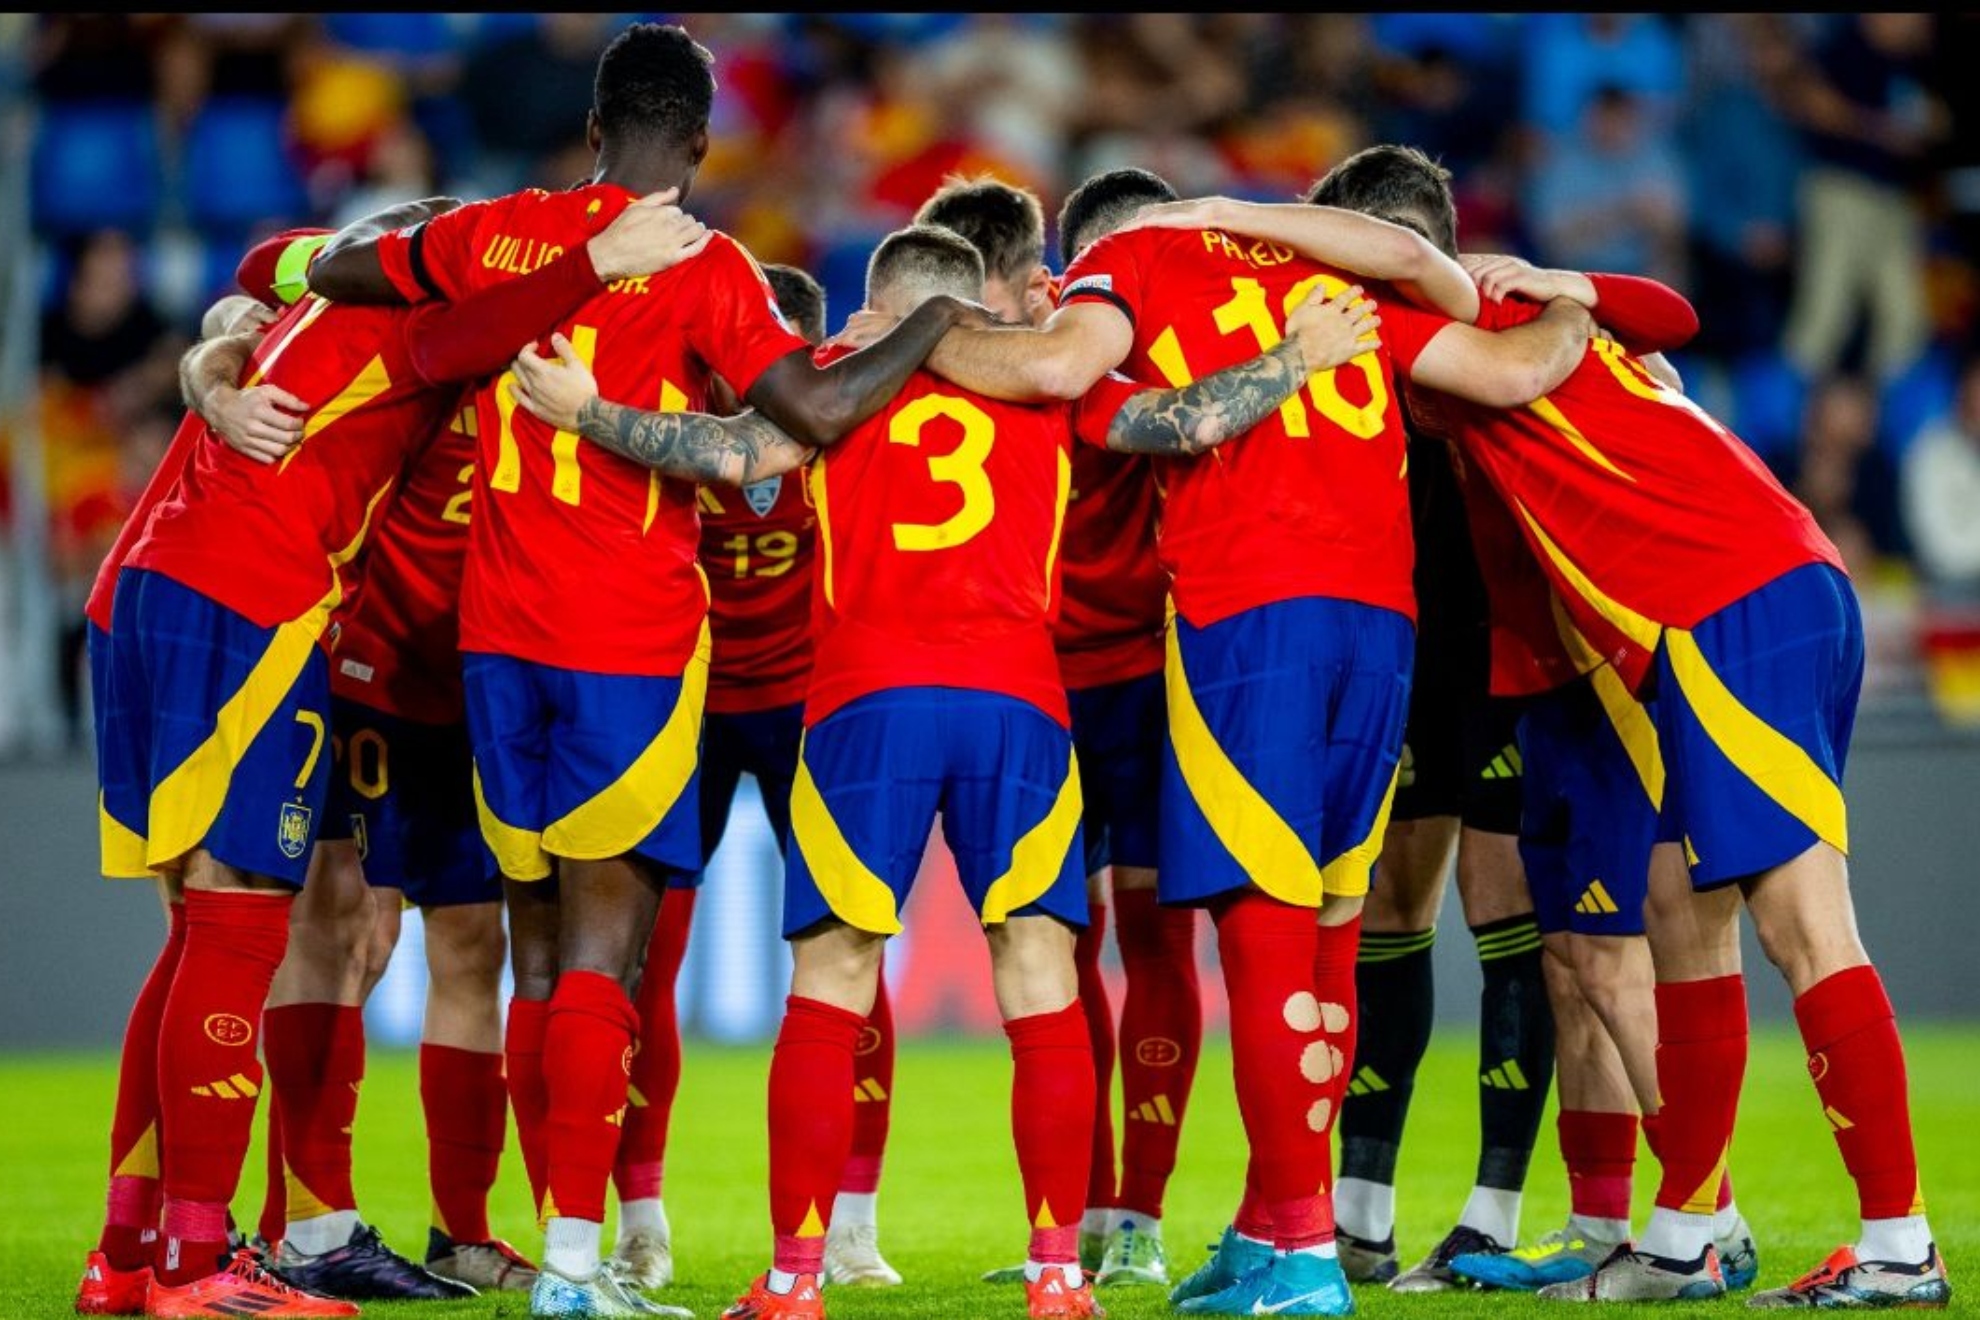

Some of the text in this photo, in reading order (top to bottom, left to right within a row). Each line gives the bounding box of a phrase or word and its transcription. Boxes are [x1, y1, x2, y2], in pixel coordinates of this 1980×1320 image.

[889, 392, 995, 552] 3
[723, 530, 798, 579] 19
[294, 708, 326, 789] 7
